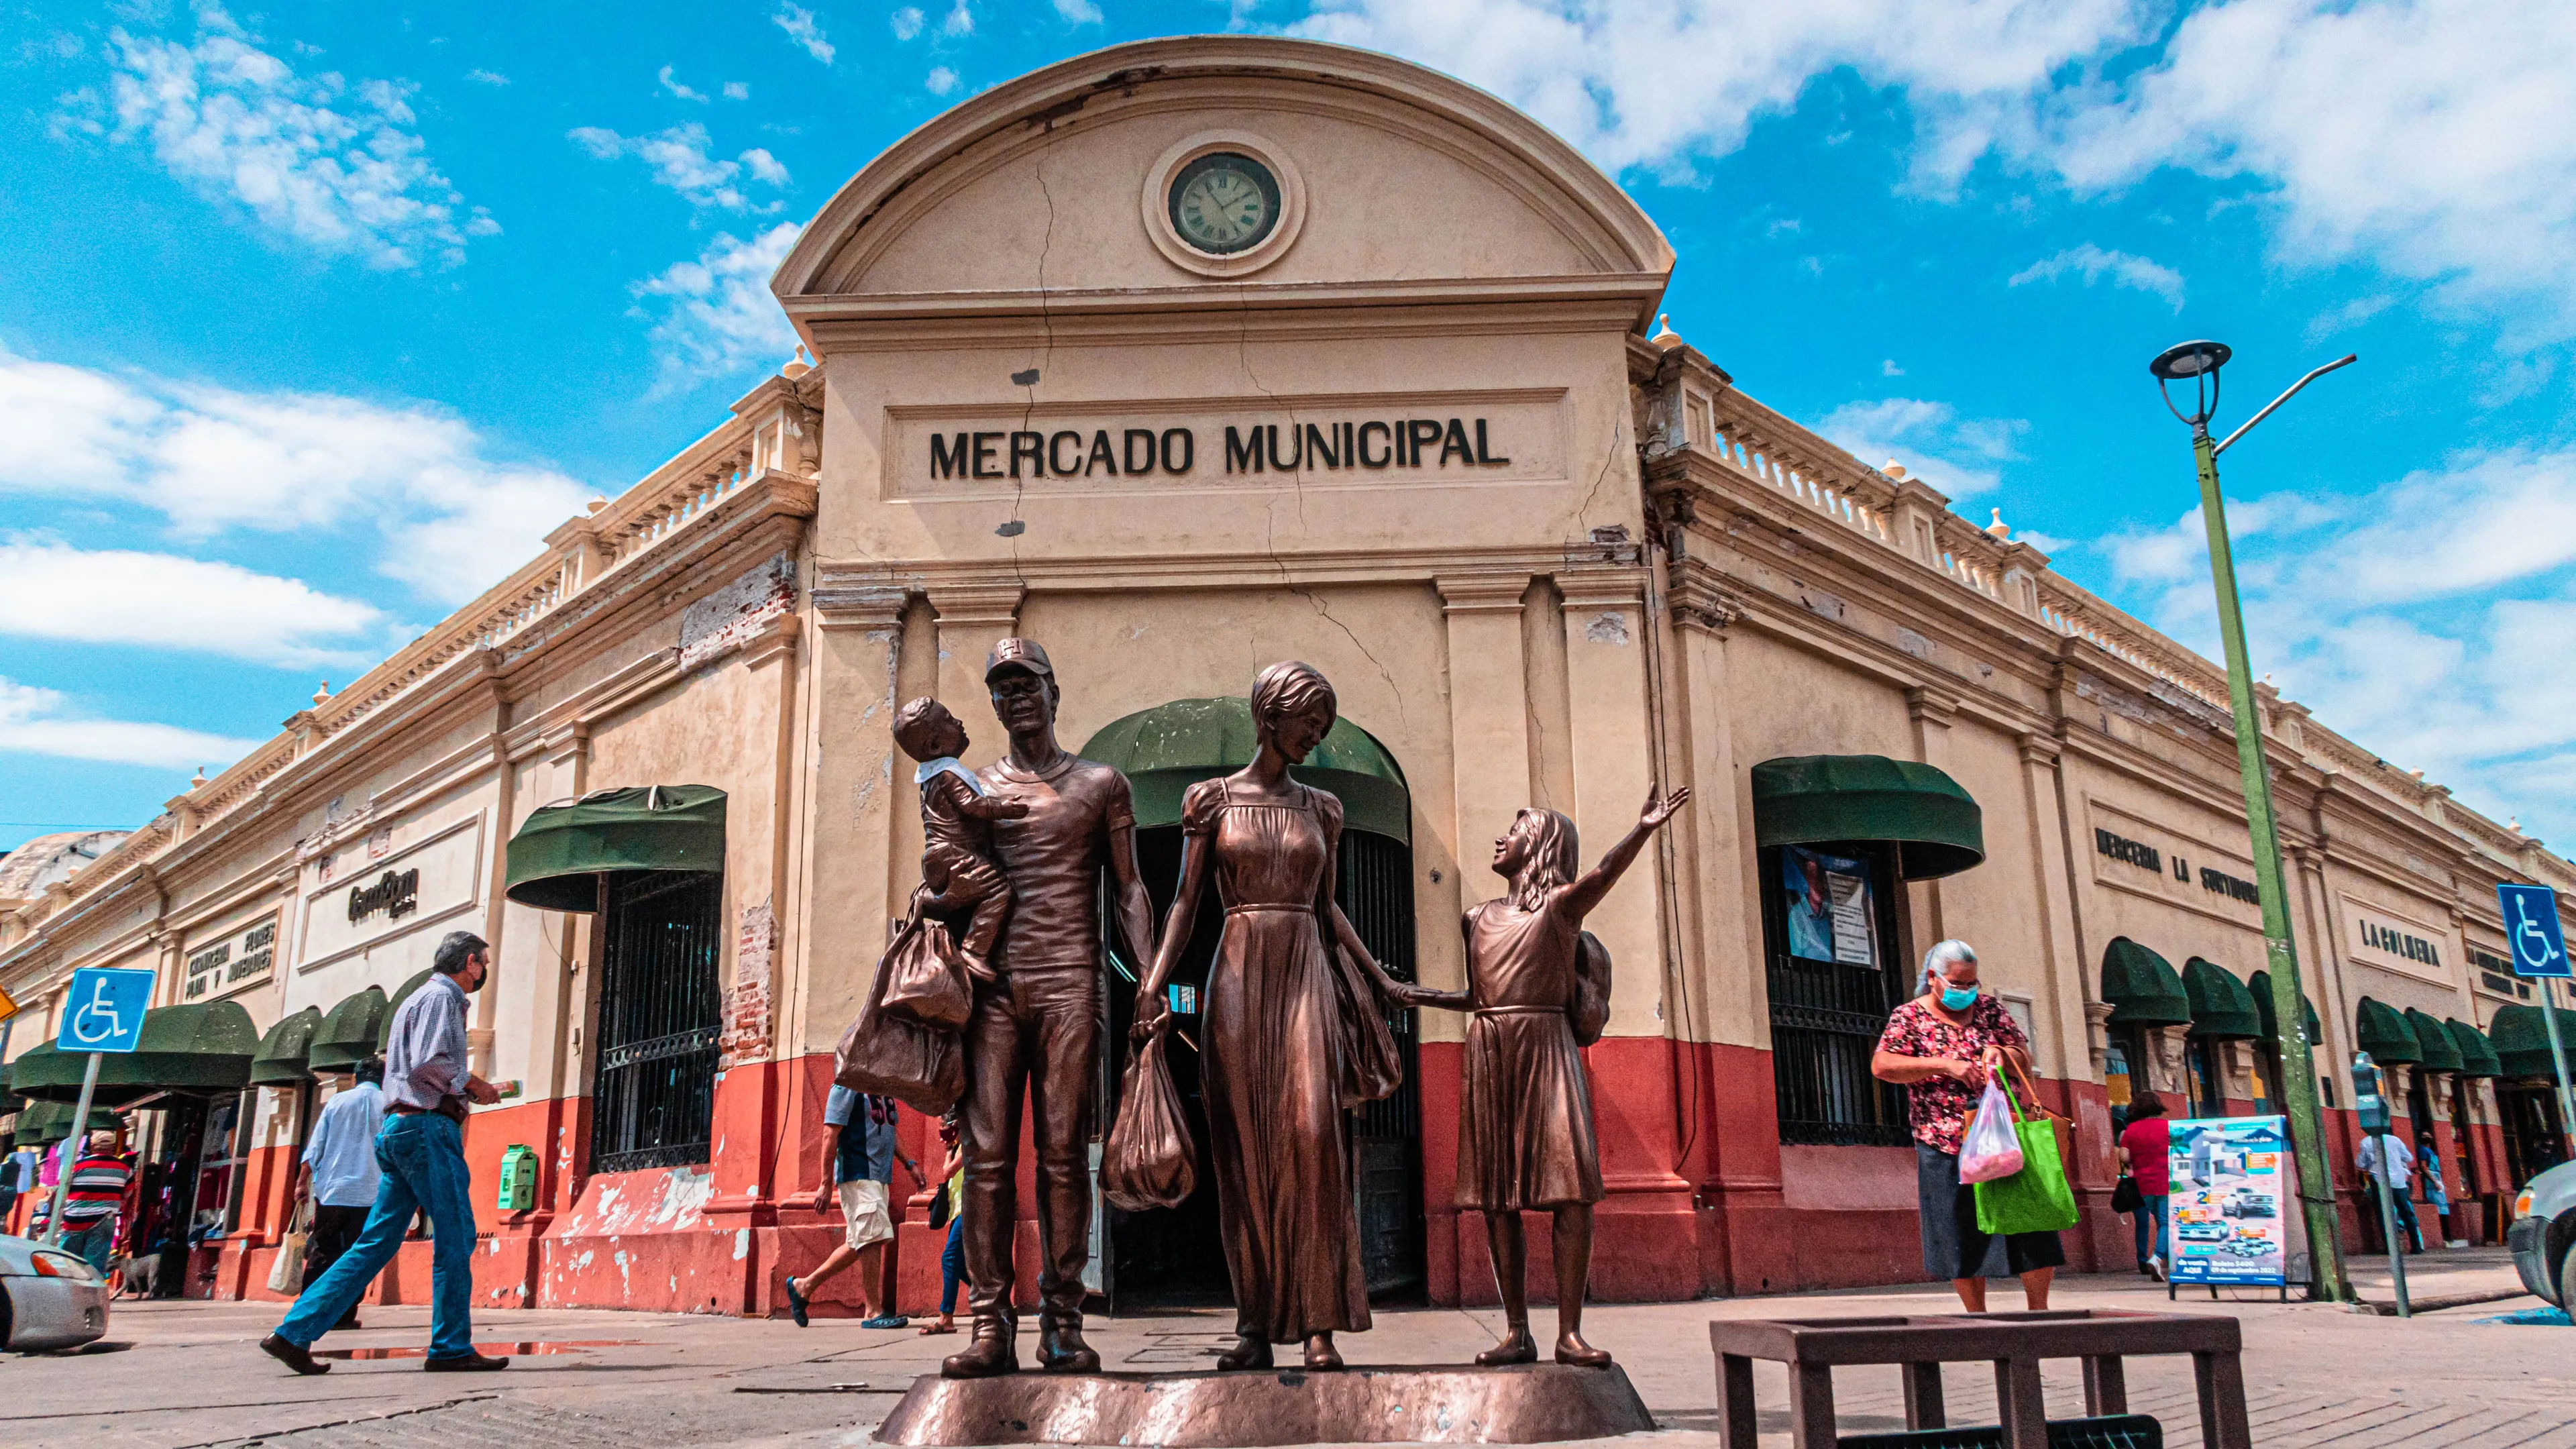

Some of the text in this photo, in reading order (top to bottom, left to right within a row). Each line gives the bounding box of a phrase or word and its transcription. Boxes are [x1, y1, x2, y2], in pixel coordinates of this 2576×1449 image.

[930, 419, 1511, 479] MERCADO MUNICIPAL
[997, 638, 1024, 660] H
[2094, 827, 2162, 873] MERCERIA
[2171, 855, 2190, 883] LA
[244, 922, 276, 953] FLORES
[215, 969, 221, 988] Y
